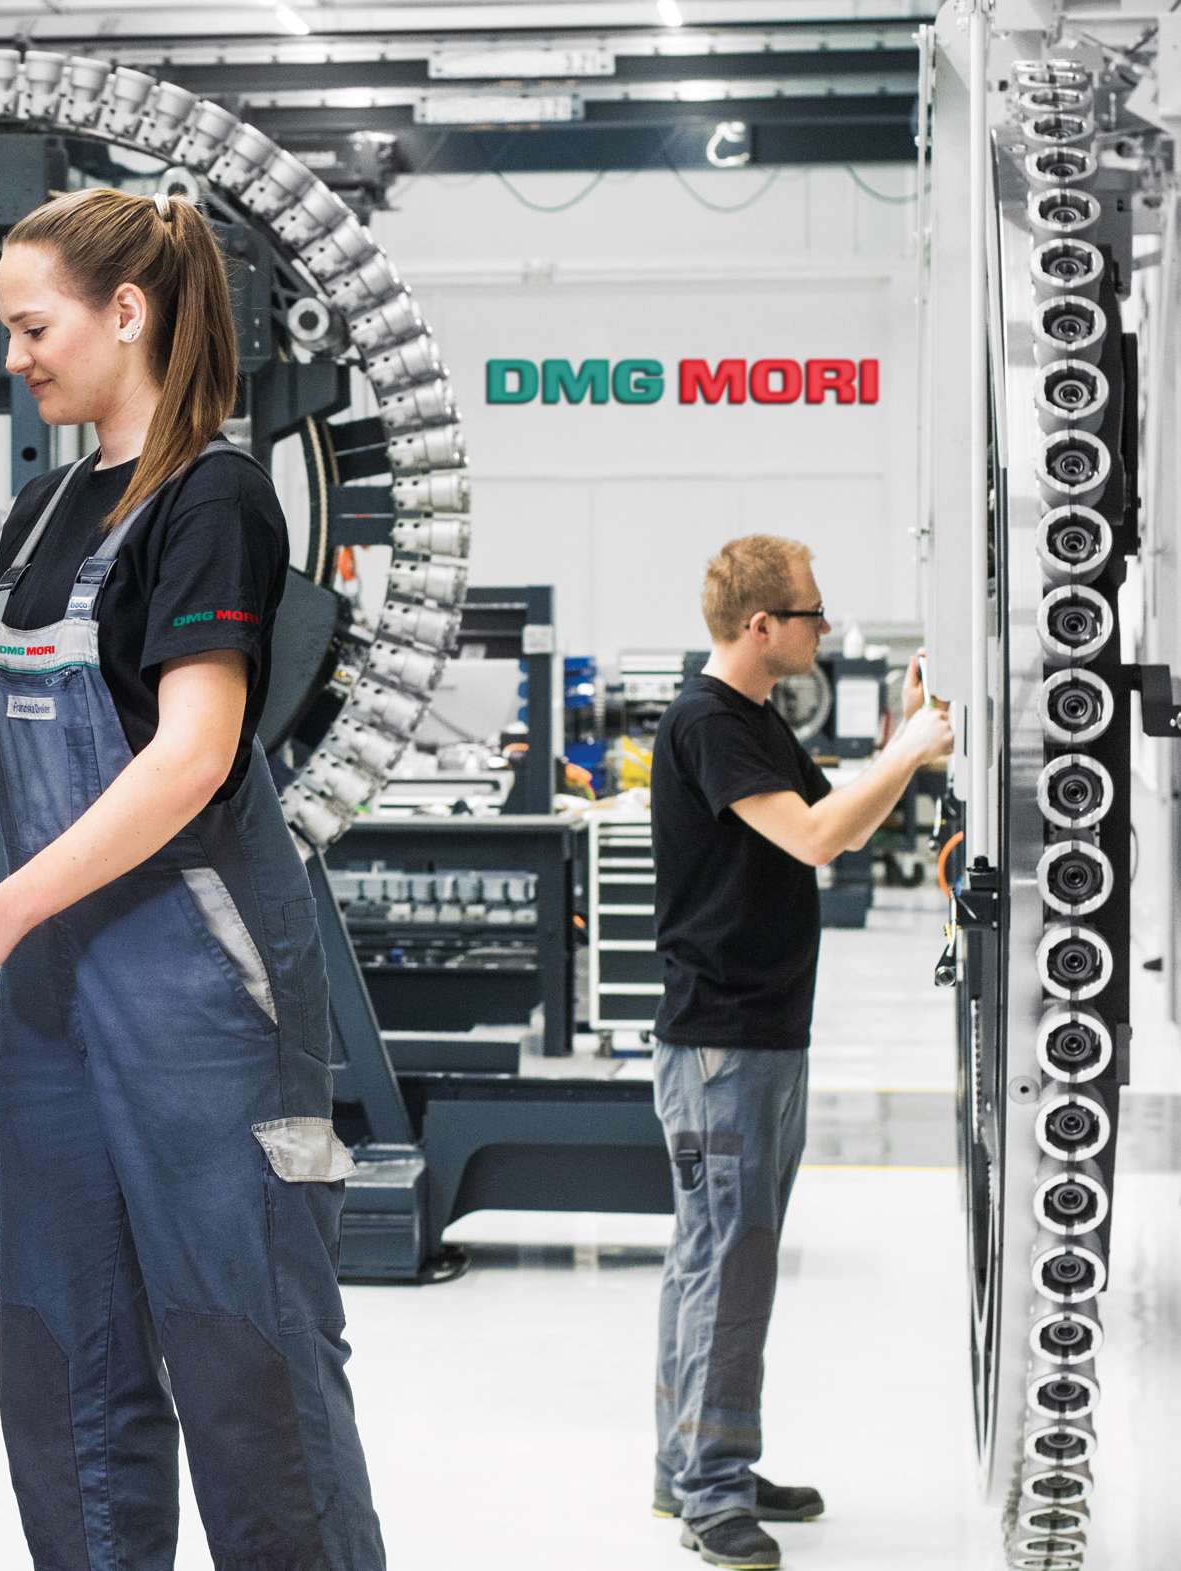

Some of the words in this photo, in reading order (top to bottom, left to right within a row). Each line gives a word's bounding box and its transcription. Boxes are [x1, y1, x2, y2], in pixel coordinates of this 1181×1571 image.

[486, 359, 665, 404] DMG
[679, 359, 879, 404] MORI
[173, 611, 214, 627] DMG
[216, 610, 260, 625] MORI
[0, 645, 25, 655] DMG
[26, 645, 55, 655] MORI
